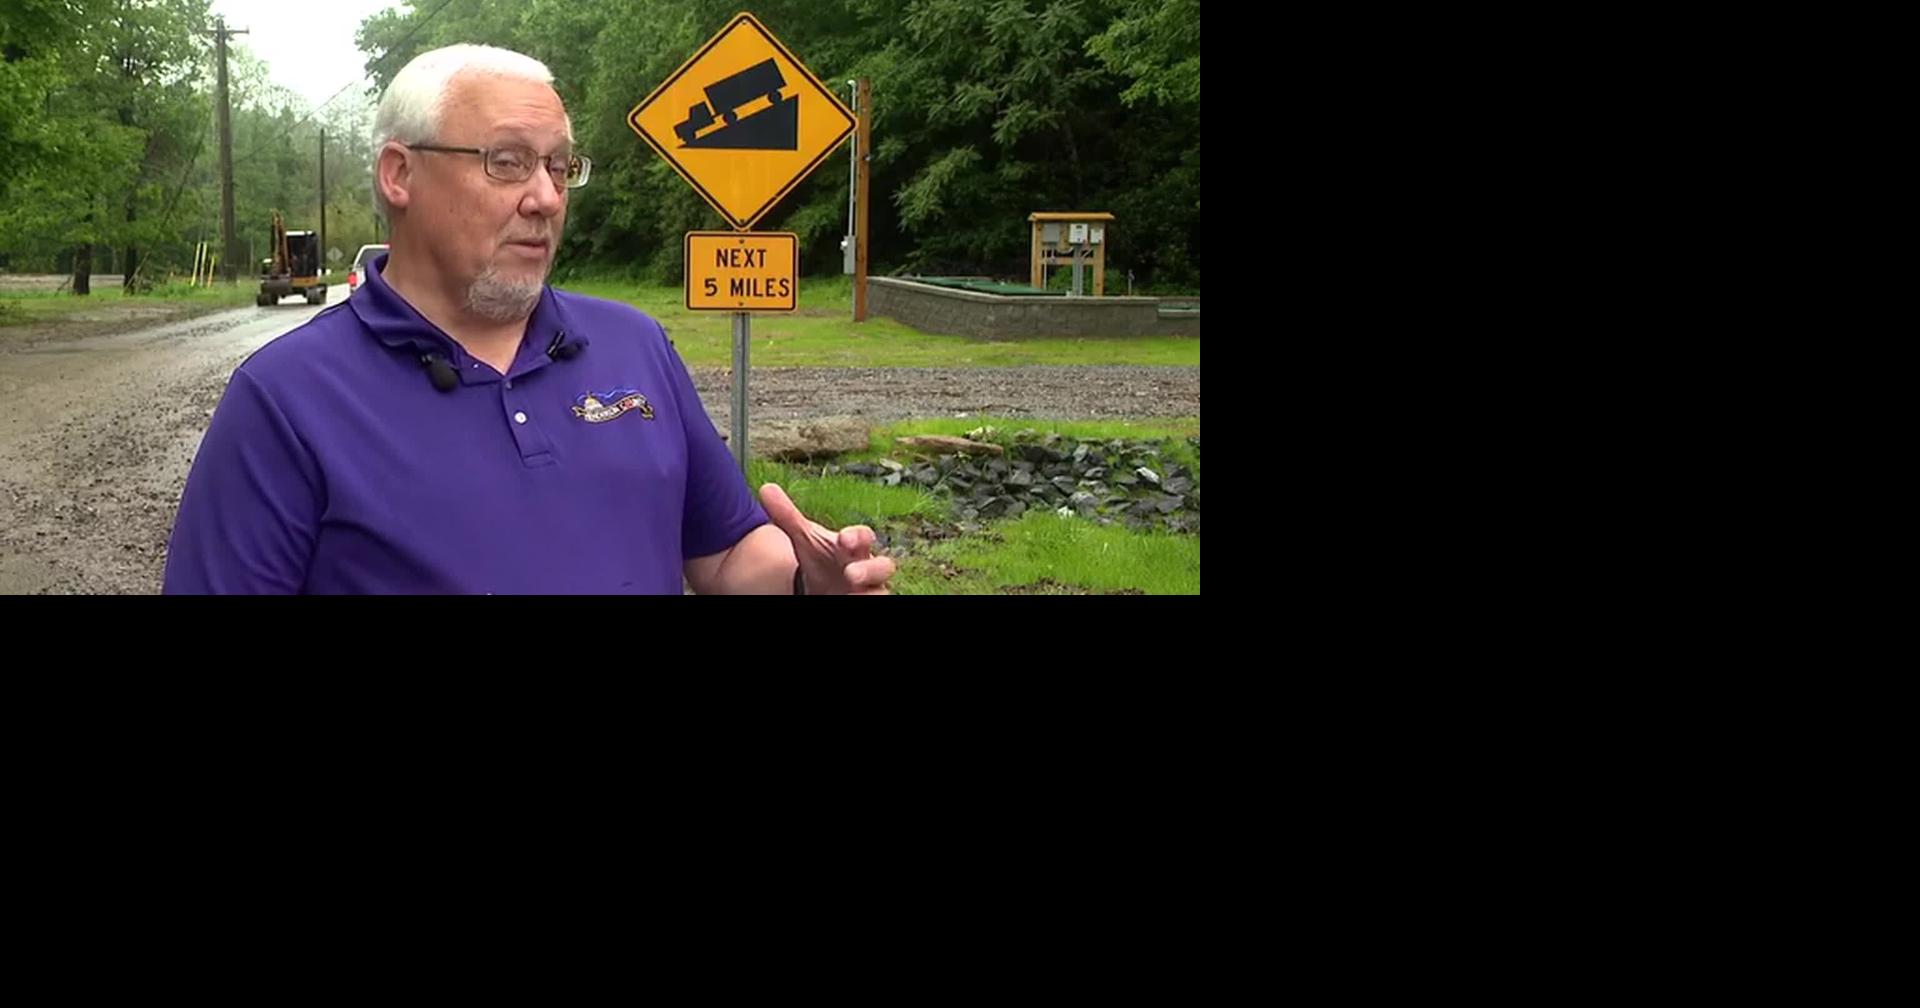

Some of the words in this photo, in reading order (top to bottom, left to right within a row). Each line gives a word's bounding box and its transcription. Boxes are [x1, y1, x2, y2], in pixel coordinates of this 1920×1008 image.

[716, 248, 767, 268] NEXT
[704, 278, 718, 297] 5
[730, 278, 790, 297] MILES
